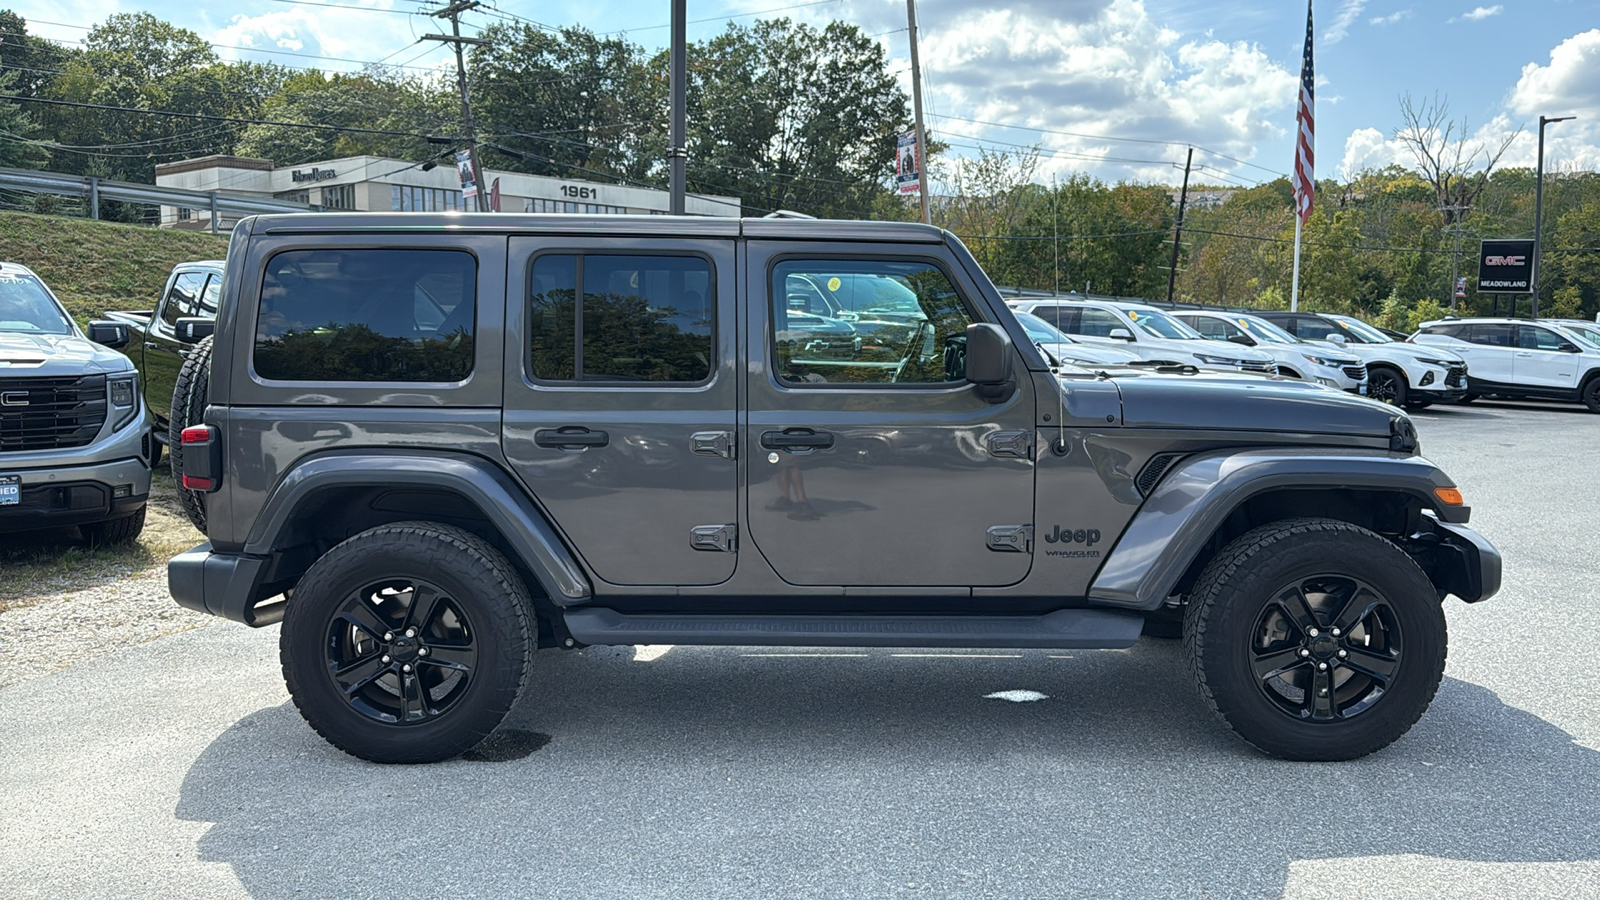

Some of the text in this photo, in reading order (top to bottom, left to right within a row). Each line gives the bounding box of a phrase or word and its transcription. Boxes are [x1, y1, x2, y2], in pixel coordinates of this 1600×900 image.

[560, 185, 597, 199] 1961
[1485, 255, 1526, 266] GMC
[1480, 280, 1527, 288] MEADOWLAND
[1044, 524, 1101, 547] Jeep
